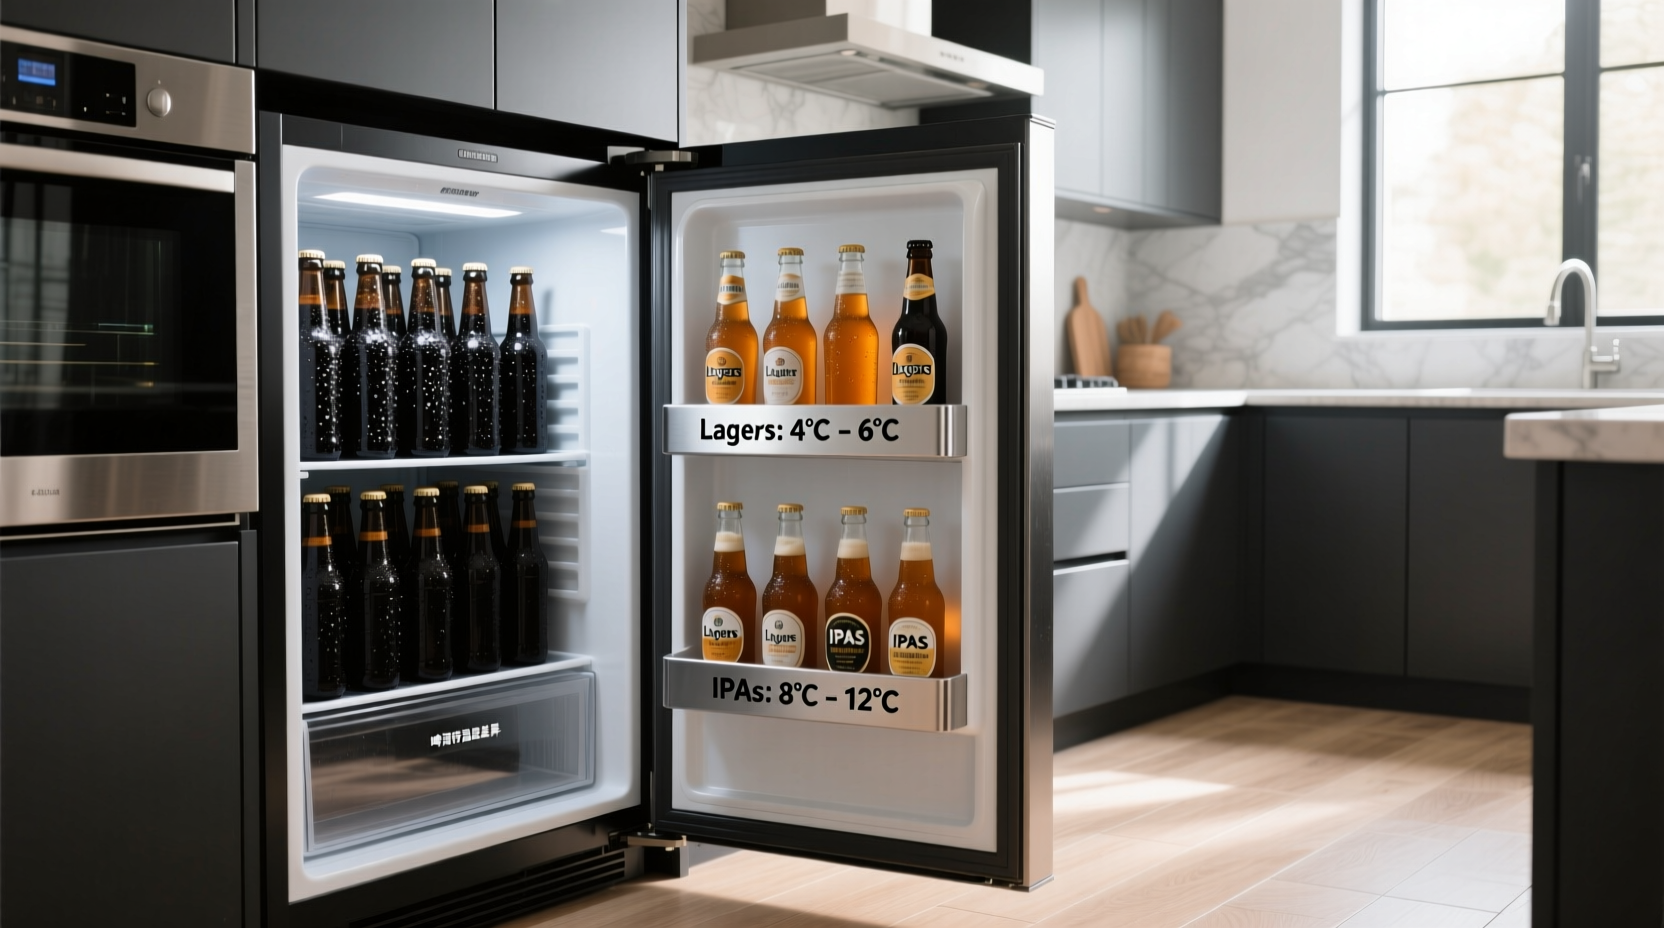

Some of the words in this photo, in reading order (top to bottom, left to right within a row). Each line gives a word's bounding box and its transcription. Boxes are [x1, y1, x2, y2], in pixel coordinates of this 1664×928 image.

[700, 418, 783, 446] Lagers:
[790, 417, 830, 441] 4°C
[858, 417, 900, 442] 6°C
[829, 628, 865, 645] IPAS
[893, 634, 928, 649] IPAS
[712, 677, 772, 703] IPAs:
[778, 681, 818, 707] 8°C
[844, 687, 899, 714] 12°C
